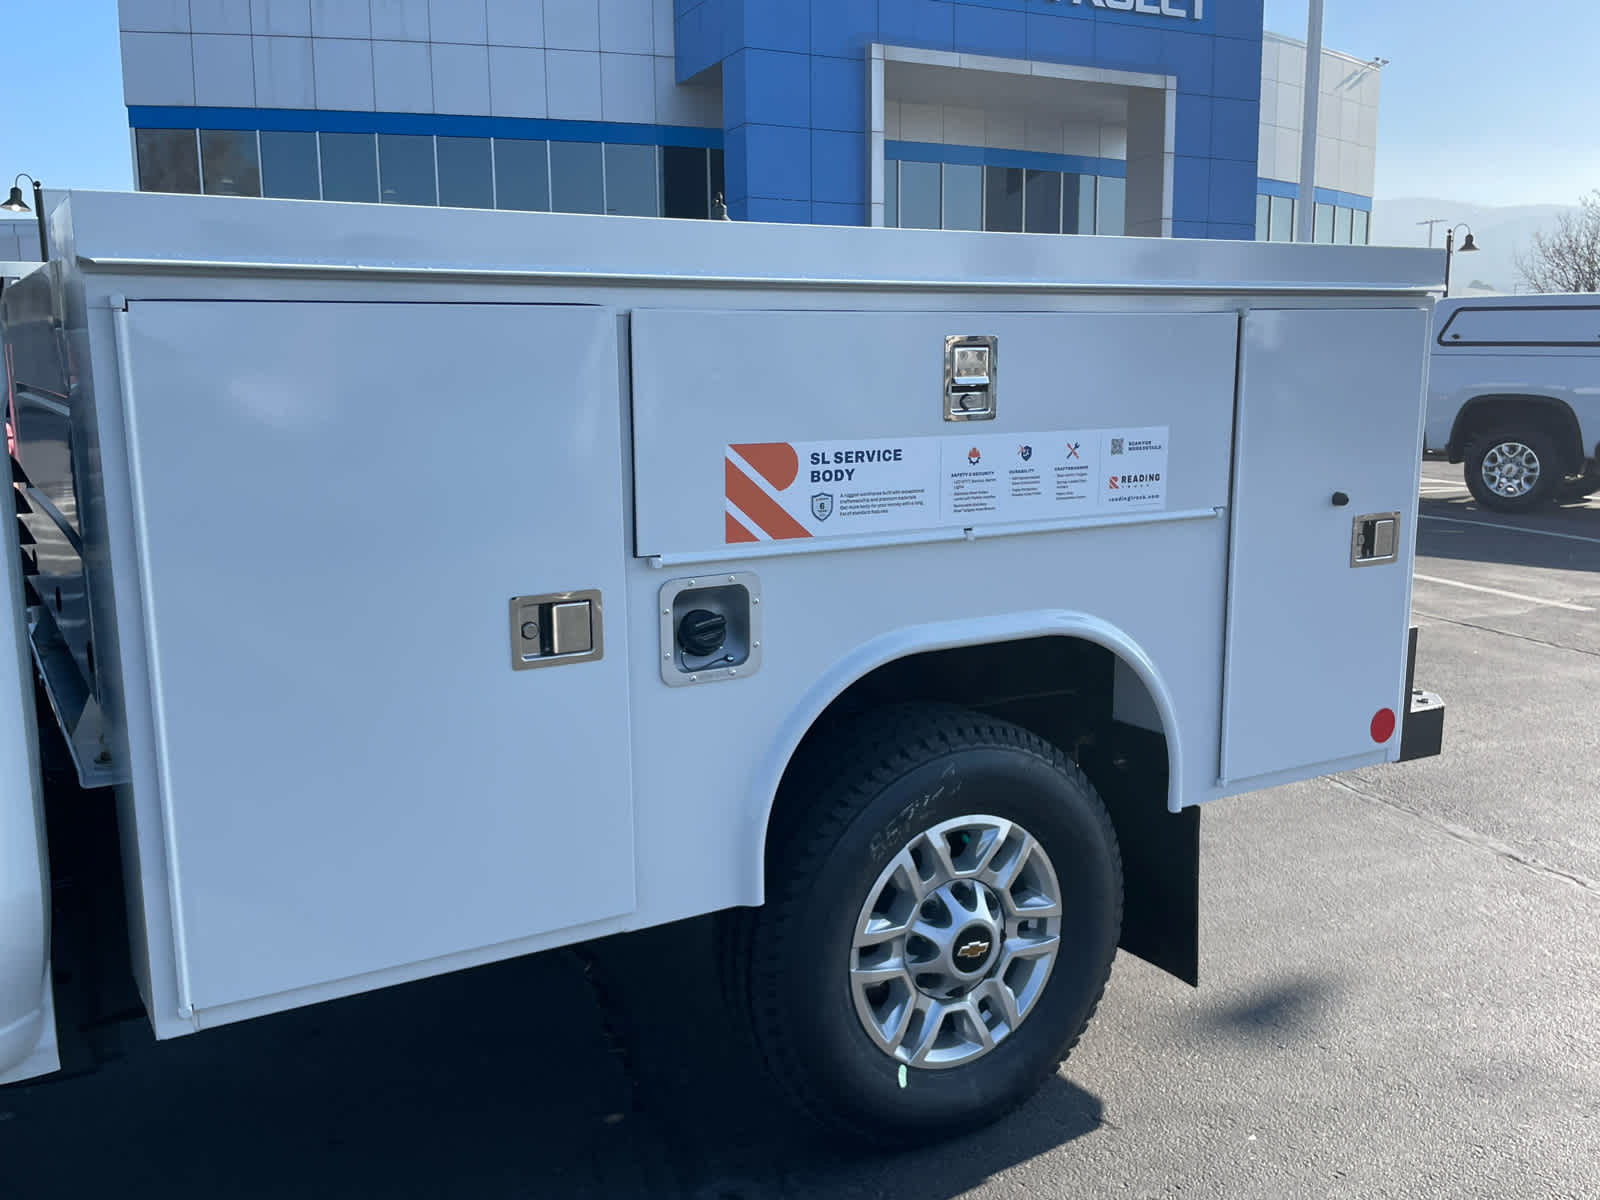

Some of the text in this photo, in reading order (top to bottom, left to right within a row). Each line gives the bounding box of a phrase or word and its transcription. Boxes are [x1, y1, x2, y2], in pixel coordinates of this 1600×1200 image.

[810, 449, 903, 465] SL SERVICE
[810, 468, 856, 483] BODY
[1121, 474, 1160, 484] READING
